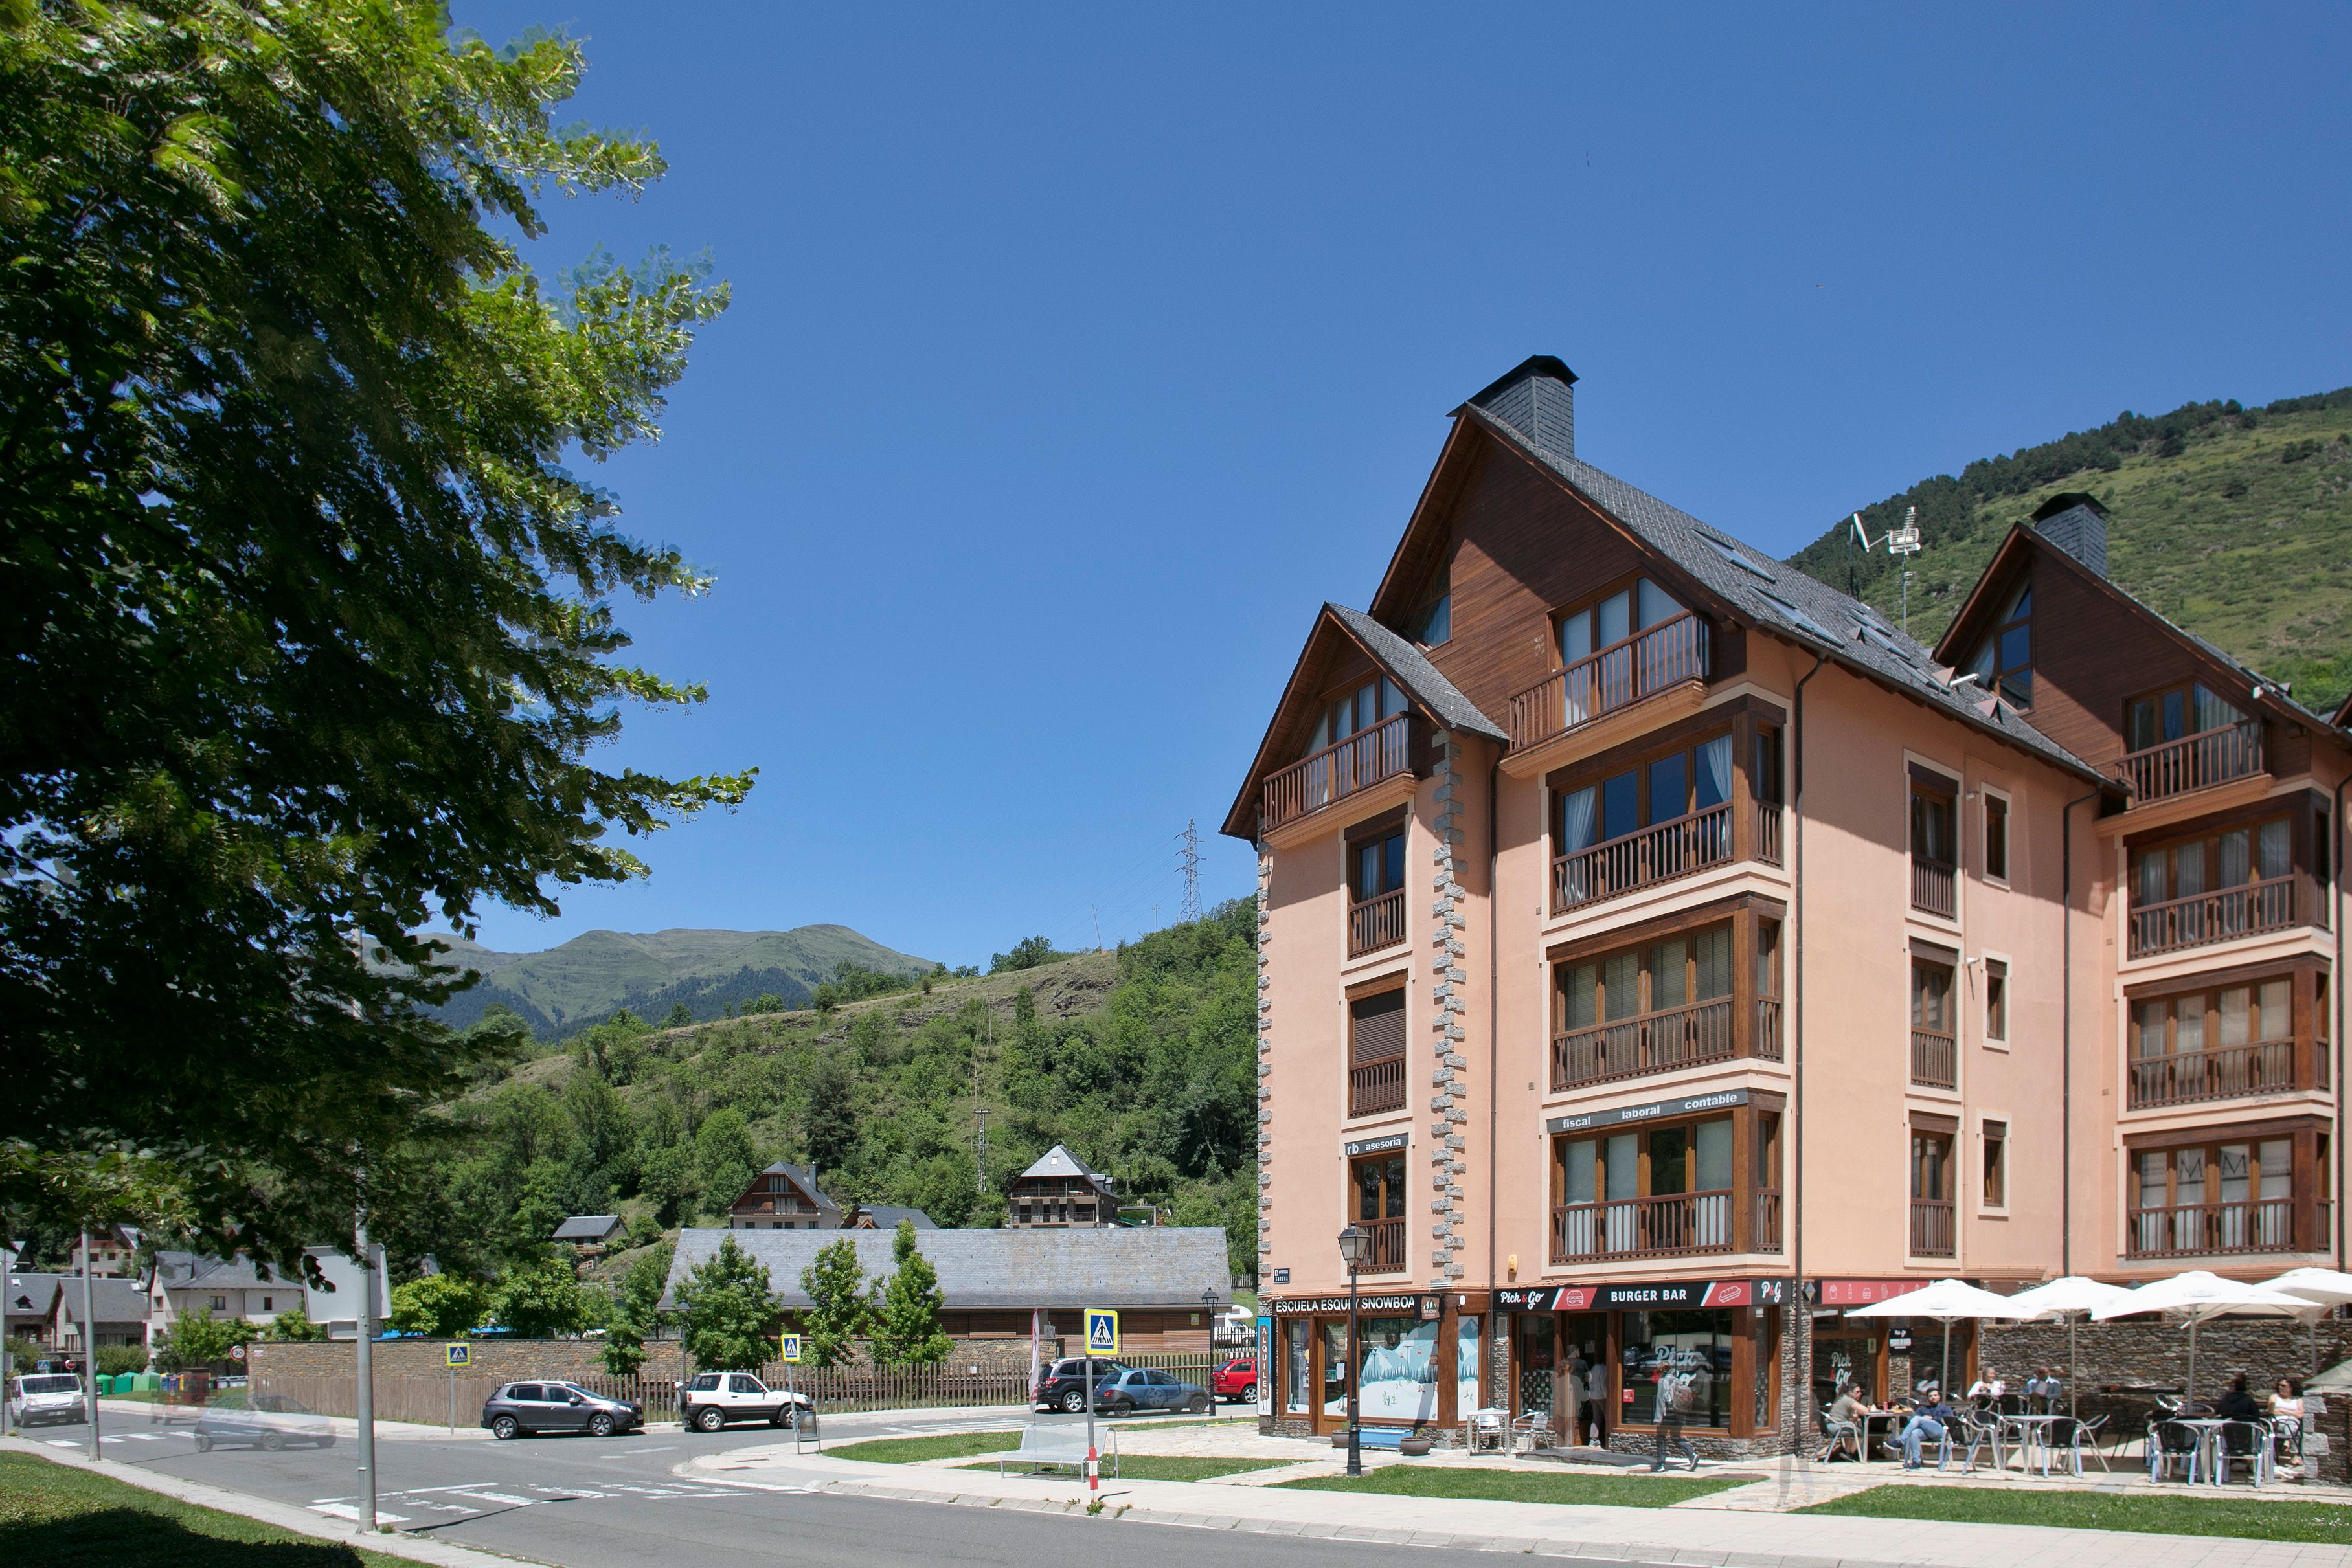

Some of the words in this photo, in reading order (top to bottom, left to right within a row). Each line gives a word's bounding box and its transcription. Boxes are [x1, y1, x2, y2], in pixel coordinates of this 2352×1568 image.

[1563, 1115, 1591, 1128] fiscal
[1622, 1105, 1660, 1119] laboral
[1684, 1093, 1737, 1110] contable
[1347, 1143, 1359, 1154] rb
[1366, 1137, 1401, 1150] asesoria
[1500, 1292, 1521, 1303] Pick
[1528, 1290, 1544, 1310] Go
[1611, 1290, 1658, 1302] BURGER
[1662, 1288, 1687, 1301] BAR
[1761, 1281, 1781, 1303] P&G
[1276, 1299, 1319, 1312] ESCUELA
[1321, 1298, 1351, 1311] ESQUI
[1831, 1352, 1852, 1367] Pick
[1835, 1367, 1852, 1393] Go
